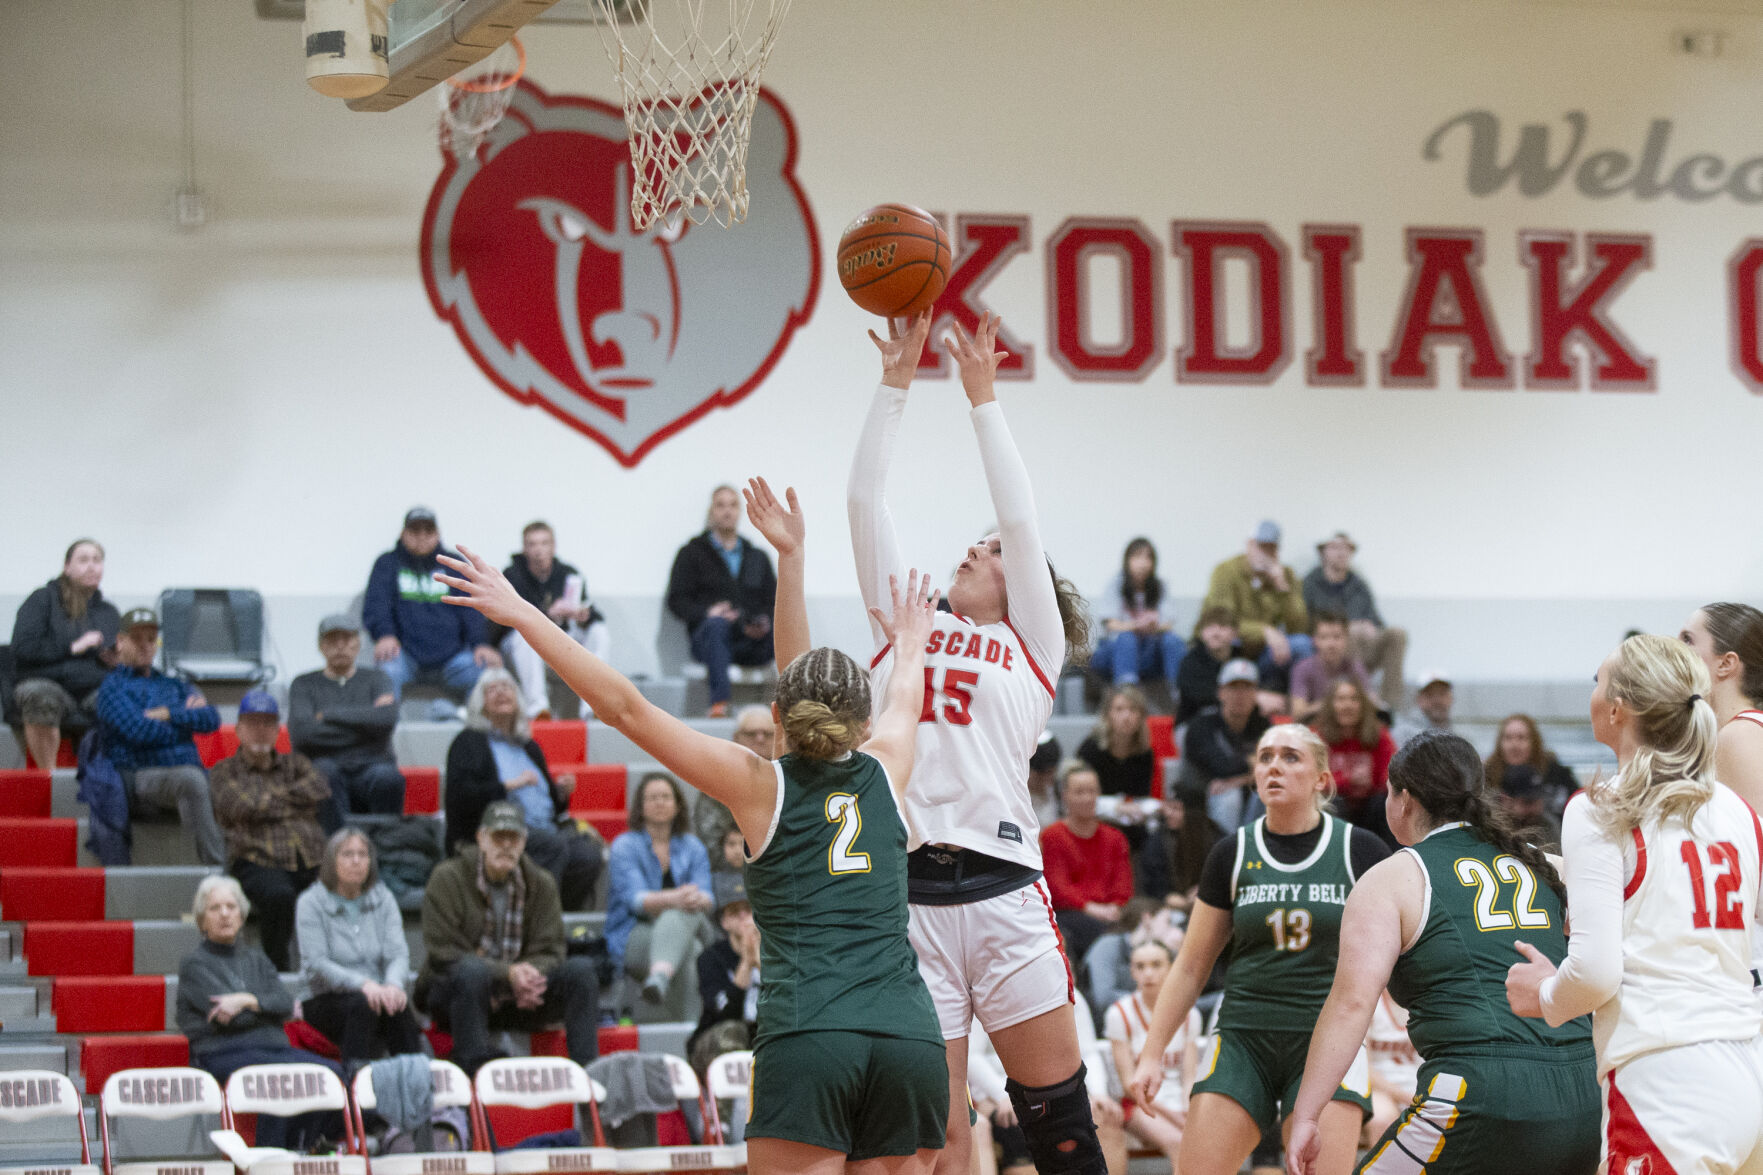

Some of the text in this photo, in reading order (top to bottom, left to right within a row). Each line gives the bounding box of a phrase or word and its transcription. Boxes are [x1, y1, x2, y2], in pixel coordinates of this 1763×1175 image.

[914, 213, 1658, 393] KODIAK
[925, 630, 1014, 671] SCADE
[918, 664, 981, 728] 15
[825, 792, 872, 875] 2
[1237, 884, 1346, 907] LIBERTY BELL
[1454, 854, 1550, 932] 22
[1680, 840, 1746, 930] 12
[1266, 908, 1313, 953] 13
[118, 1077, 204, 1104] CASCADE
[242, 1072, 327, 1100] CASCADE
[491, 1067, 575, 1092] CASCADE
